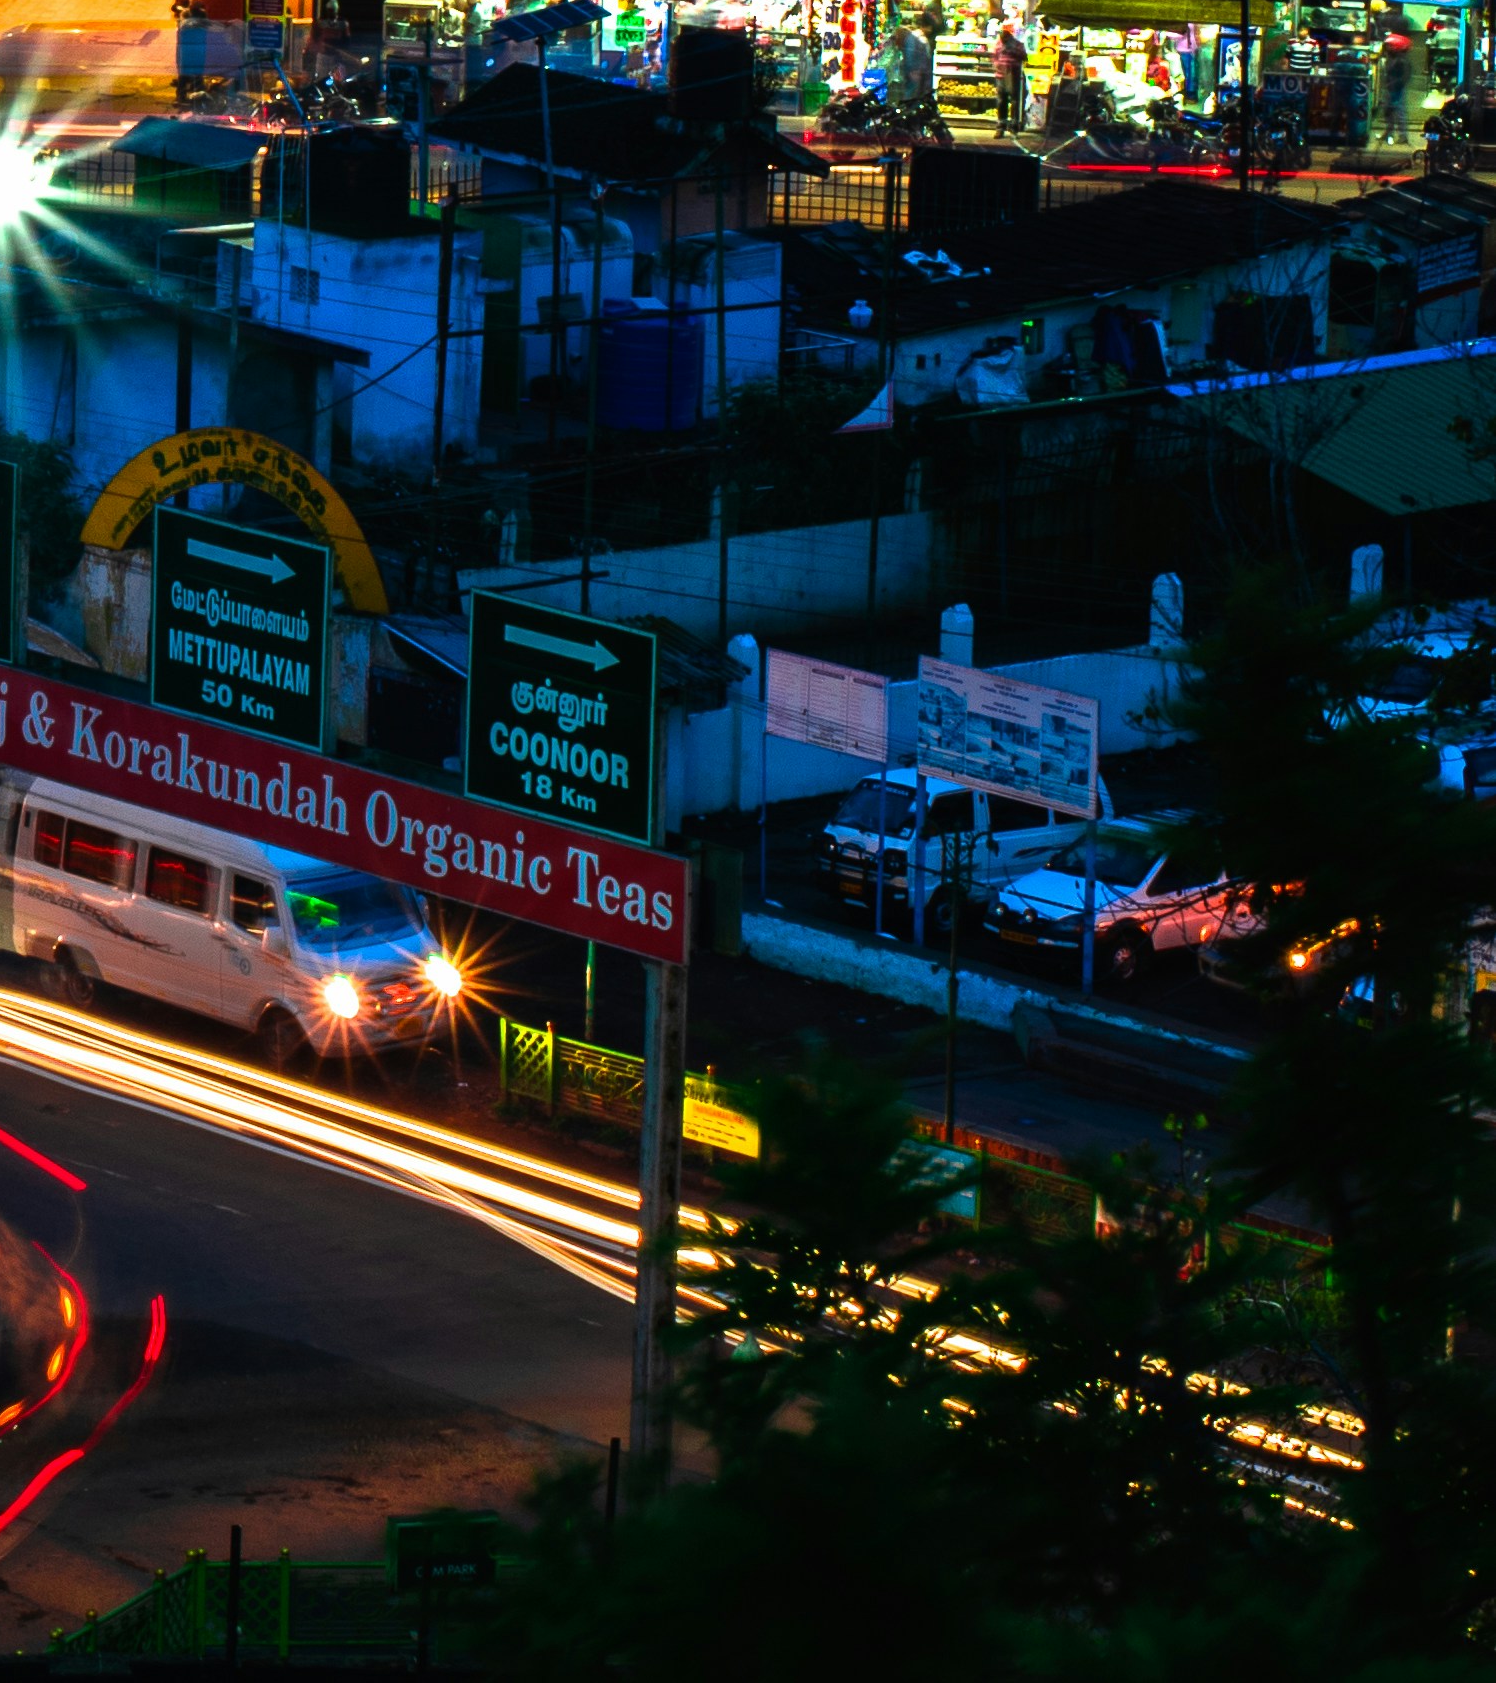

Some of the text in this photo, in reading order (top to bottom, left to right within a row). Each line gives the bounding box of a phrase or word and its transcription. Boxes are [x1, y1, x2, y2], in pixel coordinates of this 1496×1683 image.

[171, 580, 310, 644] மேட்டுப்பாளையம்
[169, 627, 311, 698] METTUPALAYAM
[201, 678, 276, 721] 50 Km
[510, 674, 610, 733] குன்னூர்
[488, 722, 631, 793] COONOOR
[22, 706, 58, 748] &
[67, 701, 350, 838] Korakundah
[366, 789, 554, 896] Organic
[566, 846, 676, 933] Teas
[519, 769, 599, 815] 18 Km
[447, 1562, 478, 1575] PARK
